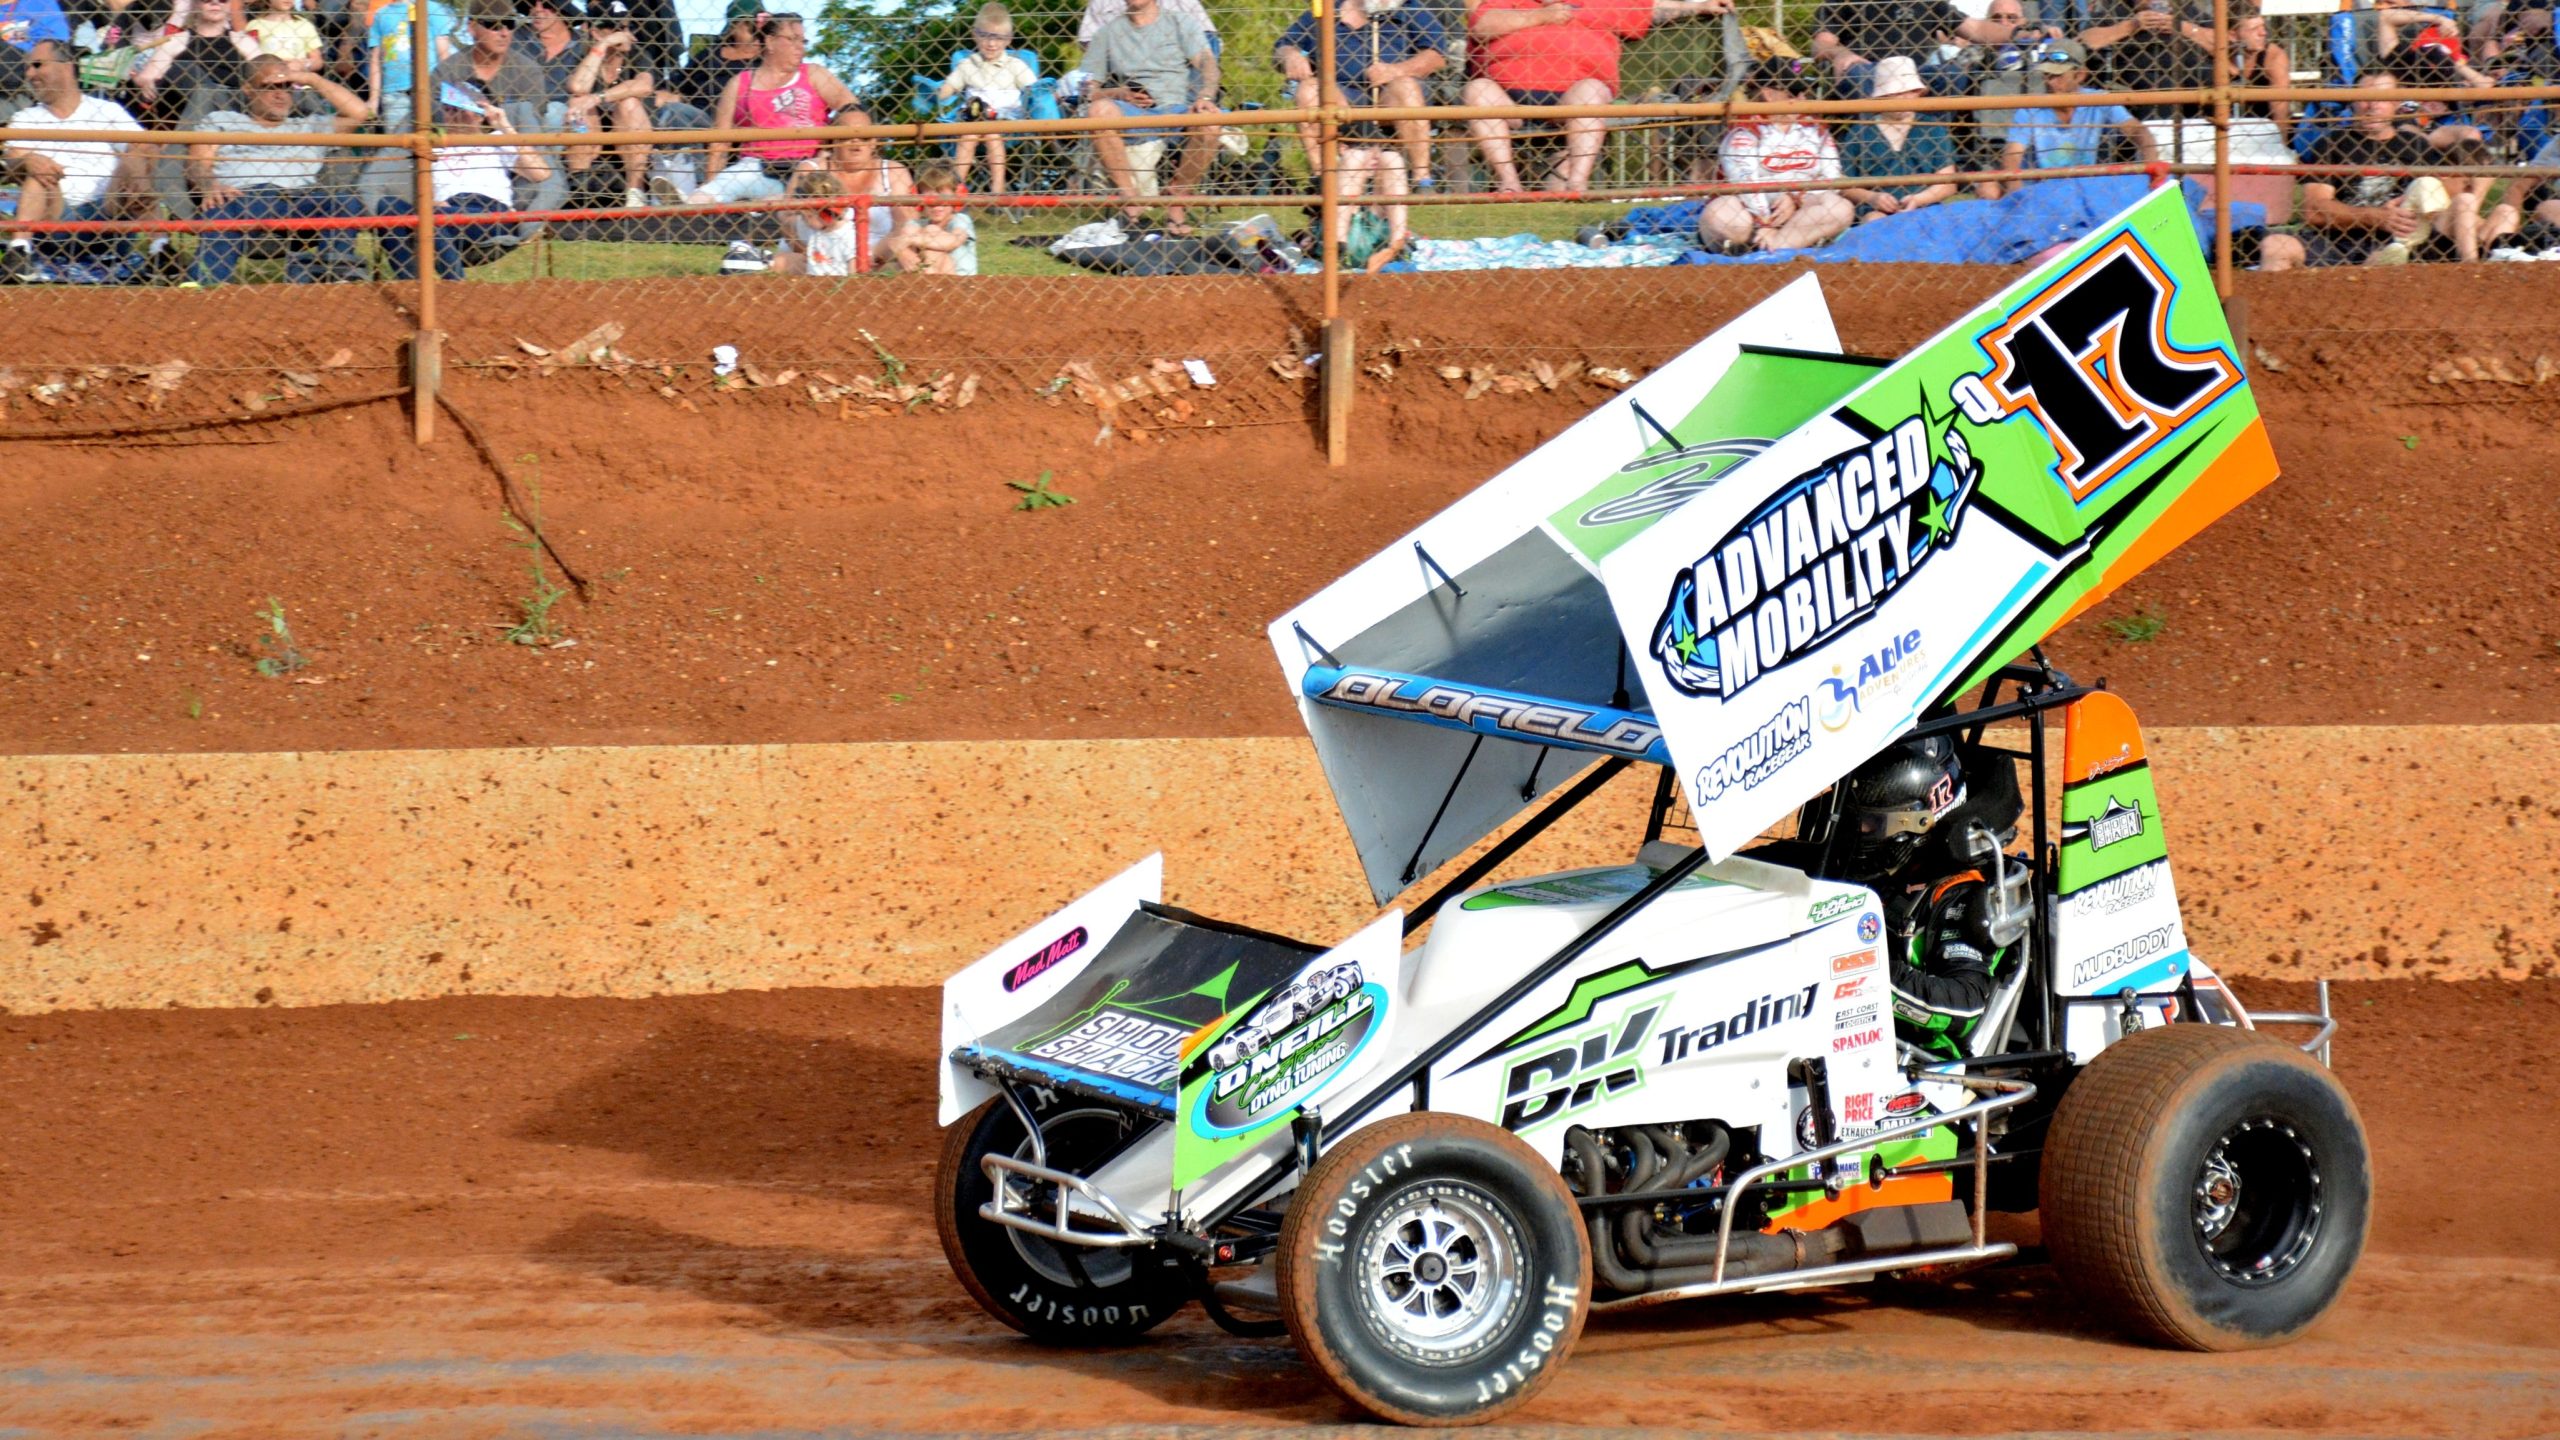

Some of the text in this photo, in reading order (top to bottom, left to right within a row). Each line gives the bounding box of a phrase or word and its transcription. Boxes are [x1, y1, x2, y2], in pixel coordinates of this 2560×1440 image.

[1983, 232, 2244, 504] 17
[1695, 416, 1931, 639] ADVANCED
[1716, 503, 1912, 698] MOBILITY
[1860, 649, 1926, 701] ADVENURES
[1696, 695, 1810, 806] REVOLUTION
[1744, 733, 1811, 791] RACEGEAR
[1930, 772, 1953, 814] 17
[2096, 813, 2136, 834] SHOCK
[2097, 826, 2137, 846] SHACK
[2074, 864, 2160, 917] REVOLUTION
[2105, 889, 2156, 915] RACEGEAR
[1012, 931, 1081, 990] Mad Matt
[2073, 923, 2175, 987] MUDBUDDY
[1080, 1016, 1184, 1057] SHOC
[1657, 982, 1820, 1066] Trading
[1836, 1002, 1878, 1021] EAST COAST
[1040, 1039, 1179, 1084] SHACK
[1217, 991, 1375, 1097] O'NEILL
[1832, 1027, 1883, 1053] SPANLOC
[1250, 1042, 1347, 1115] DYNO TUNING
[1845, 1092, 1874, 1109] RIGHT
[1845, 1107, 1873, 1123] PRICE
[1311, 1144, 1412, 1272] Hoosier
[1477, 1275, 1579, 1403] Hoosier
